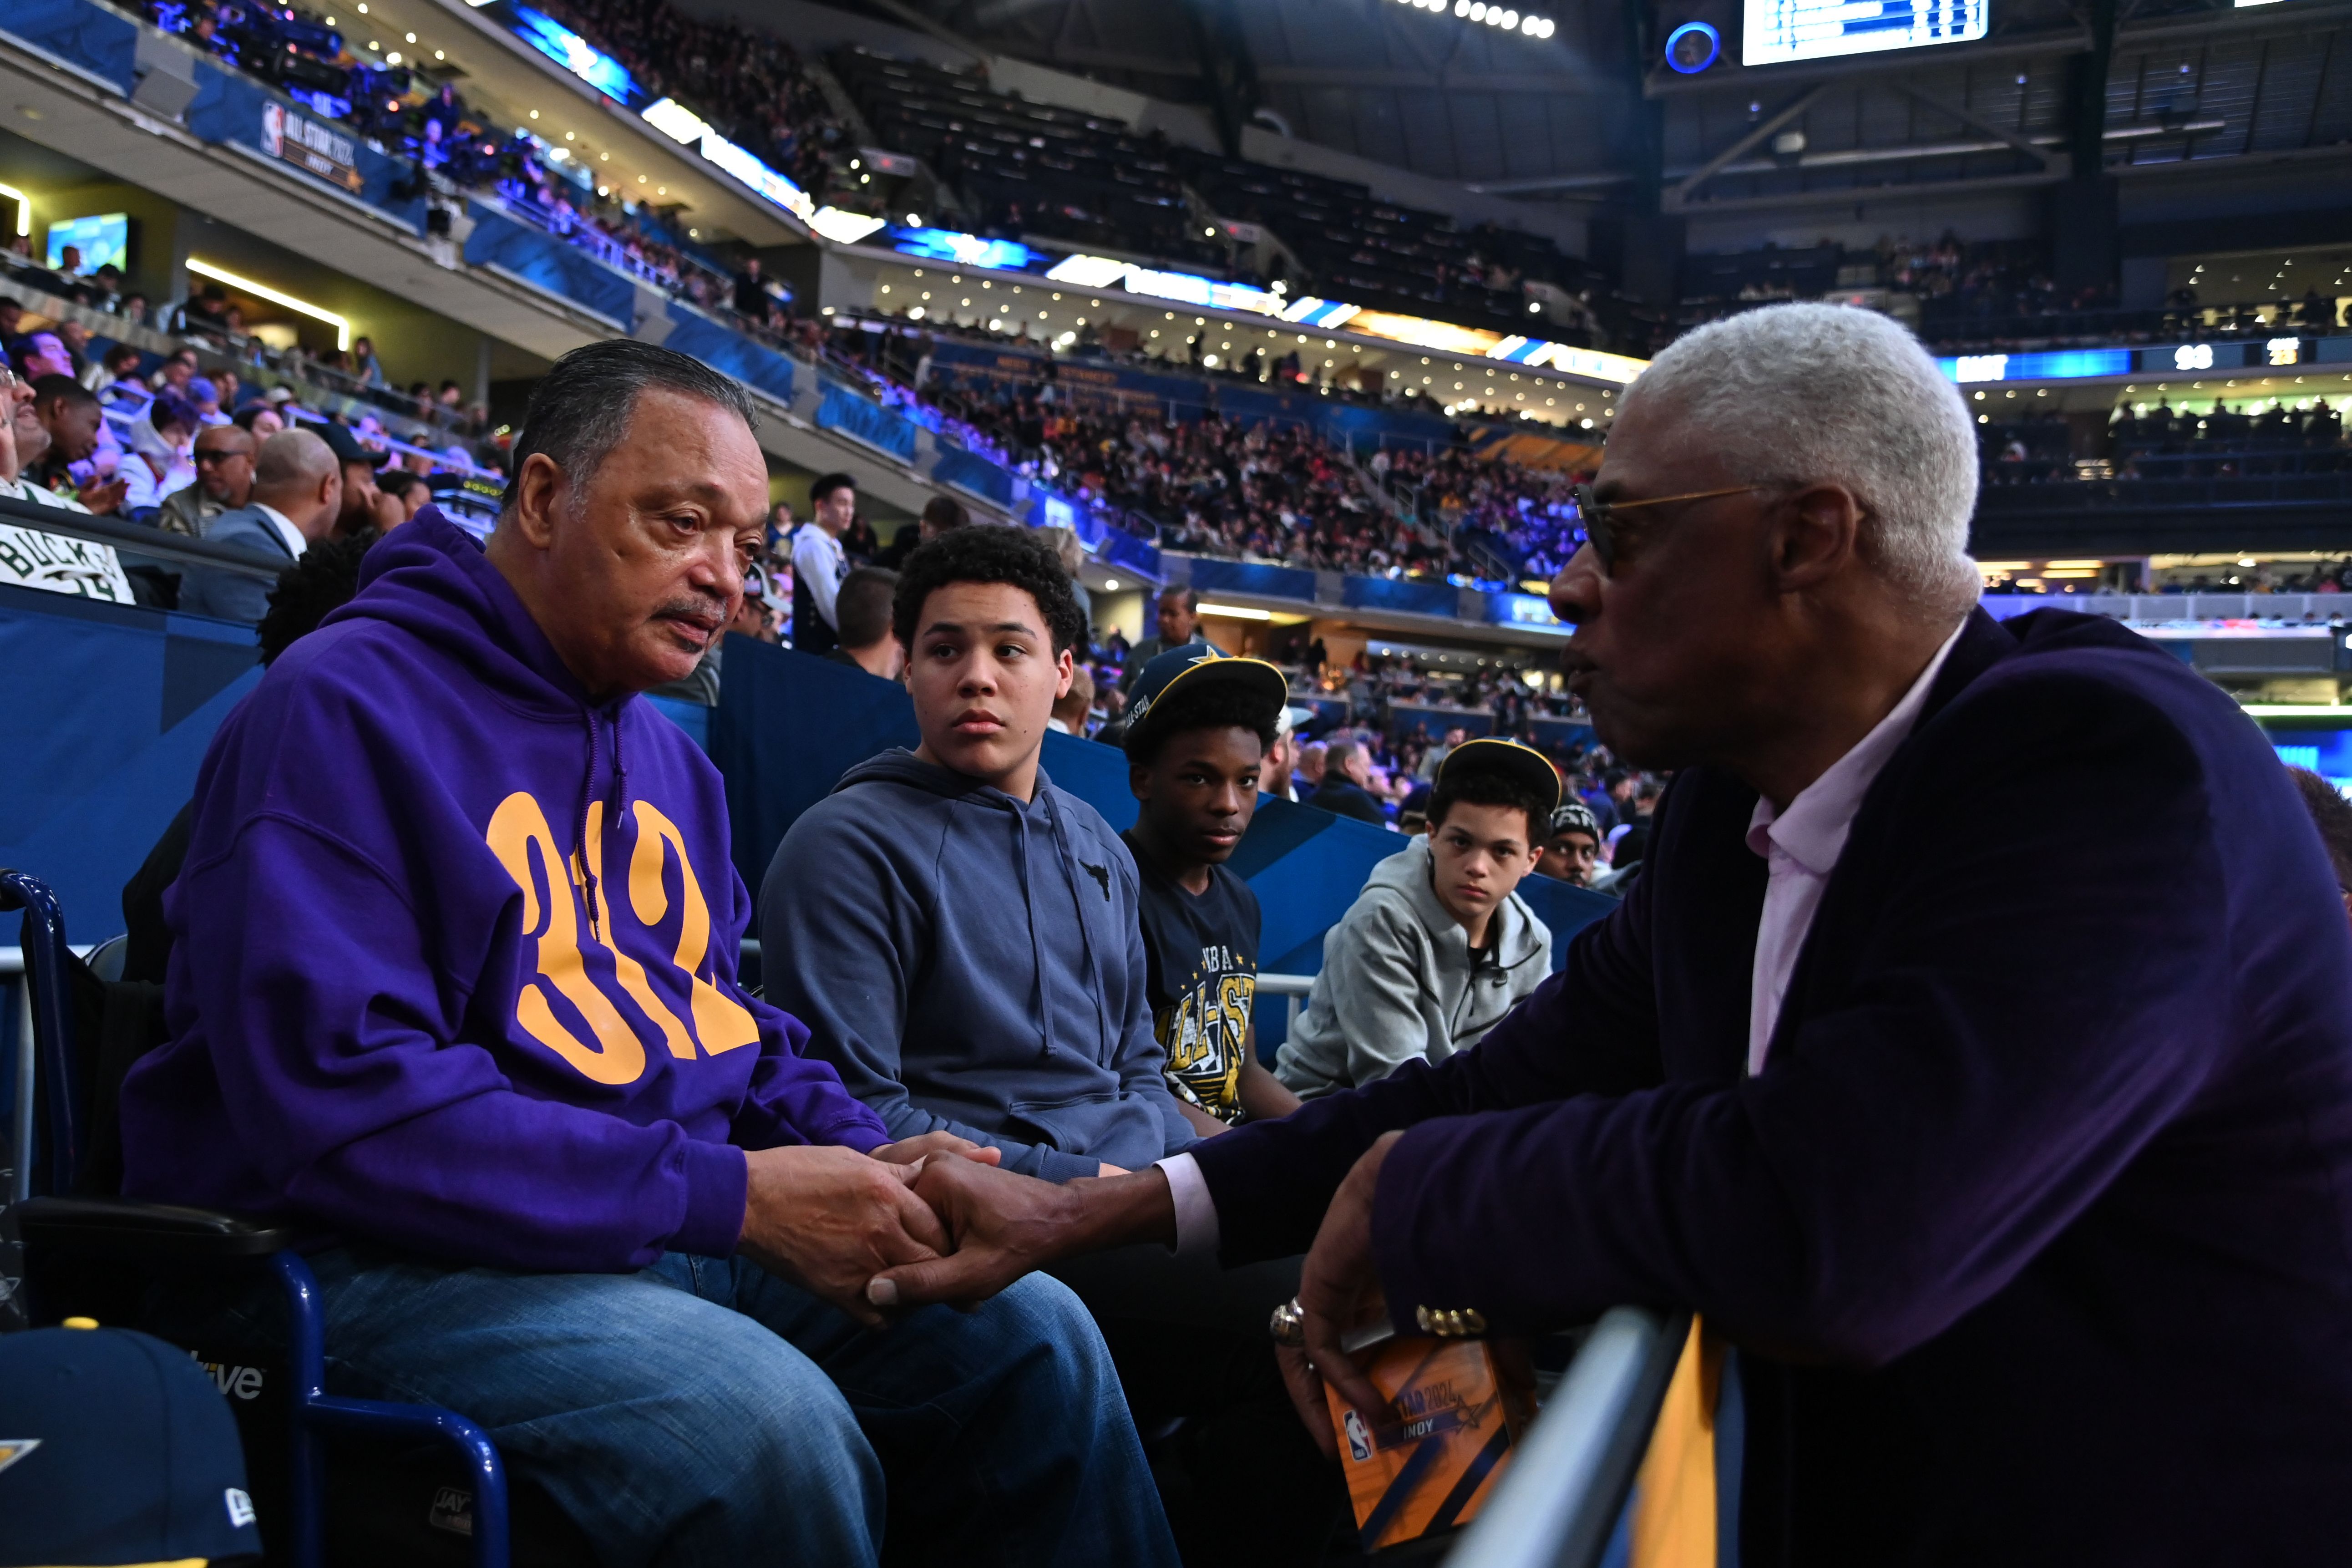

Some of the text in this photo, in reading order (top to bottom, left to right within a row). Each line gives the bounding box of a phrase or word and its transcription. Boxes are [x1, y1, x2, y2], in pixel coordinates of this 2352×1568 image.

[0, 531, 117, 579] BUCKS
[1202, 945, 1233, 973] NBA
[1403, 1418, 1434, 1440] INDY
